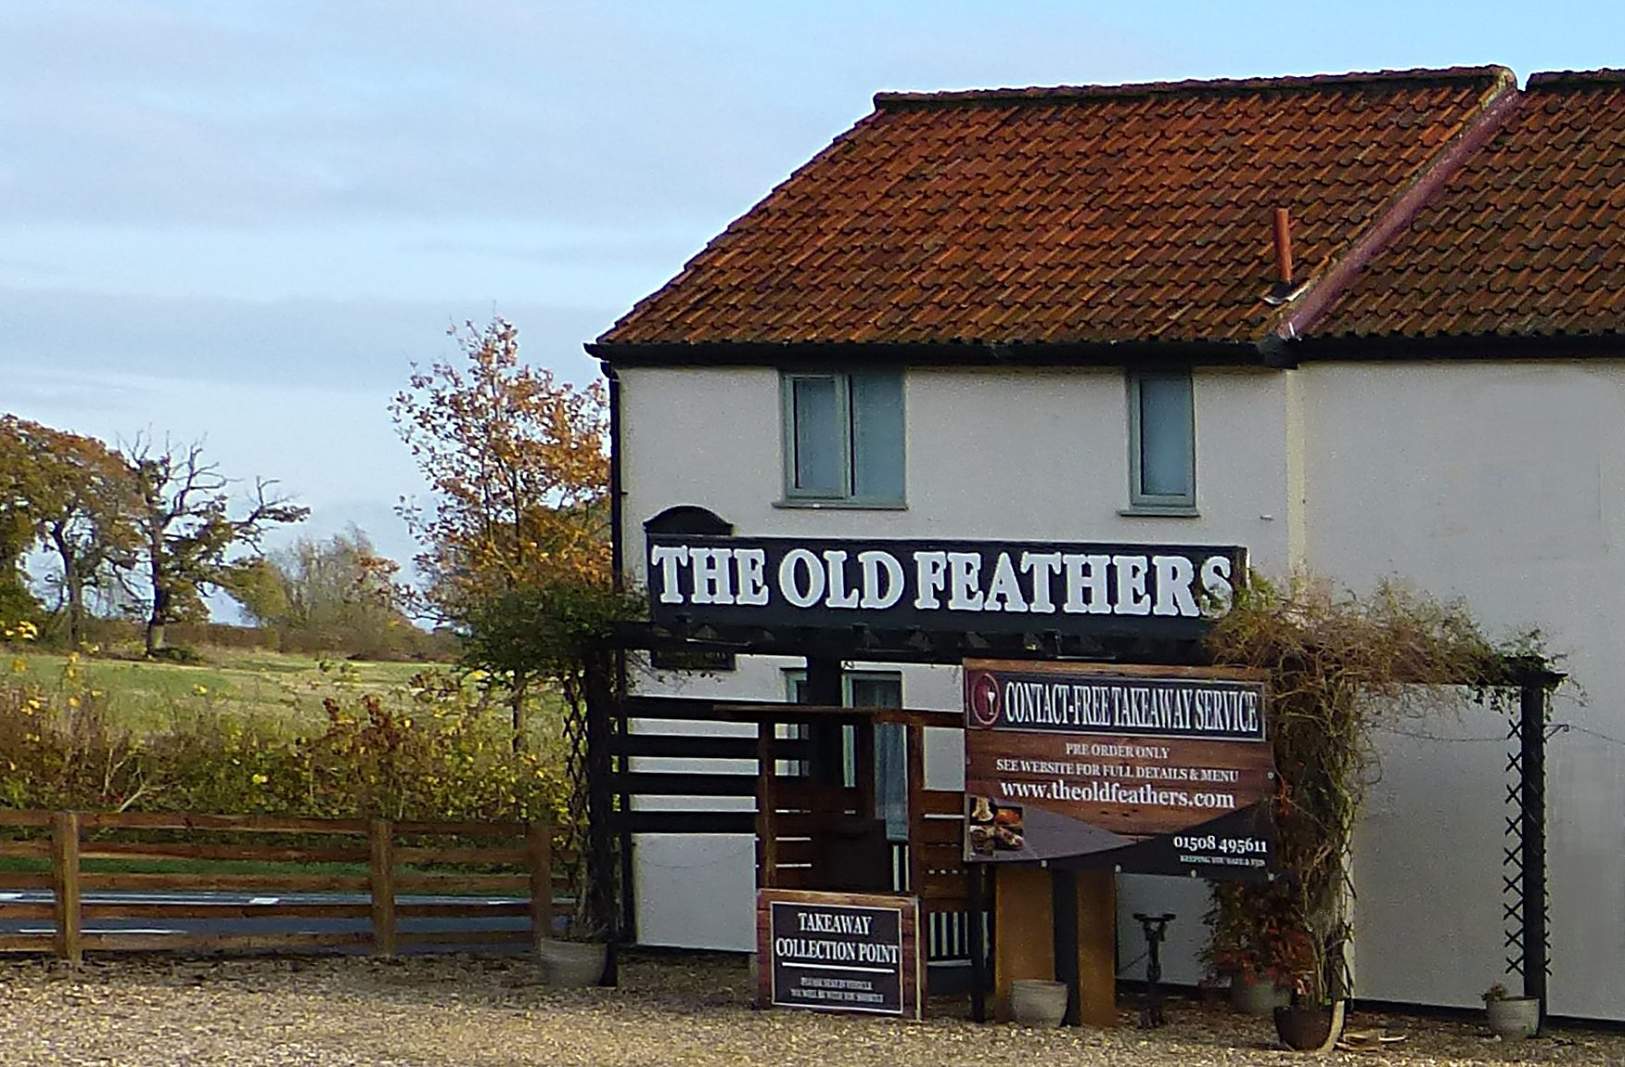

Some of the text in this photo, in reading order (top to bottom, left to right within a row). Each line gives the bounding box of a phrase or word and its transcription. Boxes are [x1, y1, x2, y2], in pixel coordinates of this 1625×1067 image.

[651, 545, 1233, 619] THE OLD FEATHERS
[1005, 681, 1259, 732] CONTACT-FREE TAKEAWAY SERVICE
[1066, 743, 1170, 759] PRE ORDER ONLY
[996, 759, 1239, 782] SEE WEBSITE FOR FULL DETAILS & MENU
[1001, 779, 1235, 808] www.theoldfeathers.com
[1173, 835, 1268, 854] 01508 495611
[798, 912, 872, 935] TAKEAWAY
[776, 938, 898, 964] COLLECTION POINT
